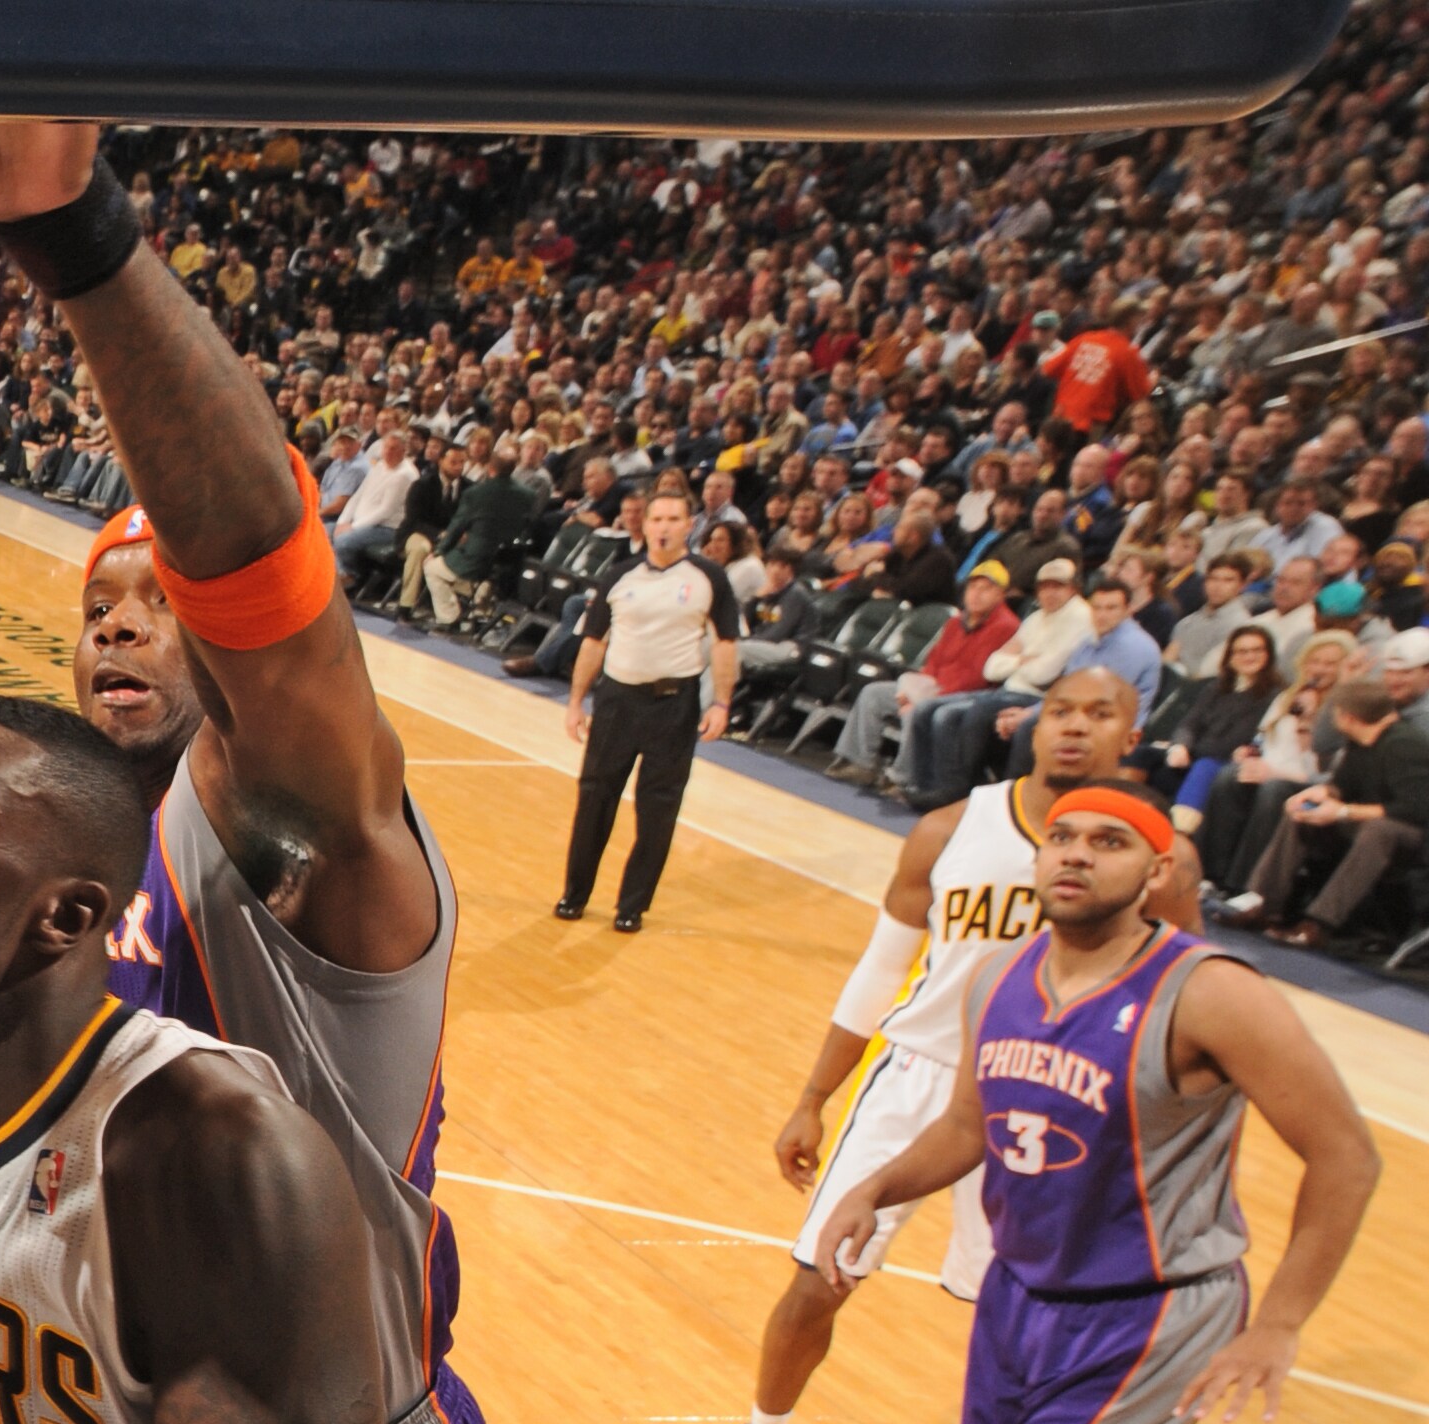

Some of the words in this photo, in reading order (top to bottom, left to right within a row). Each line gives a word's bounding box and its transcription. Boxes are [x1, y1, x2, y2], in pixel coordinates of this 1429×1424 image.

[942, 883, 1047, 942] PAC
[976, 1037, 1114, 1114] PHOENIX
[1002, 1110, 1050, 1176] 3
